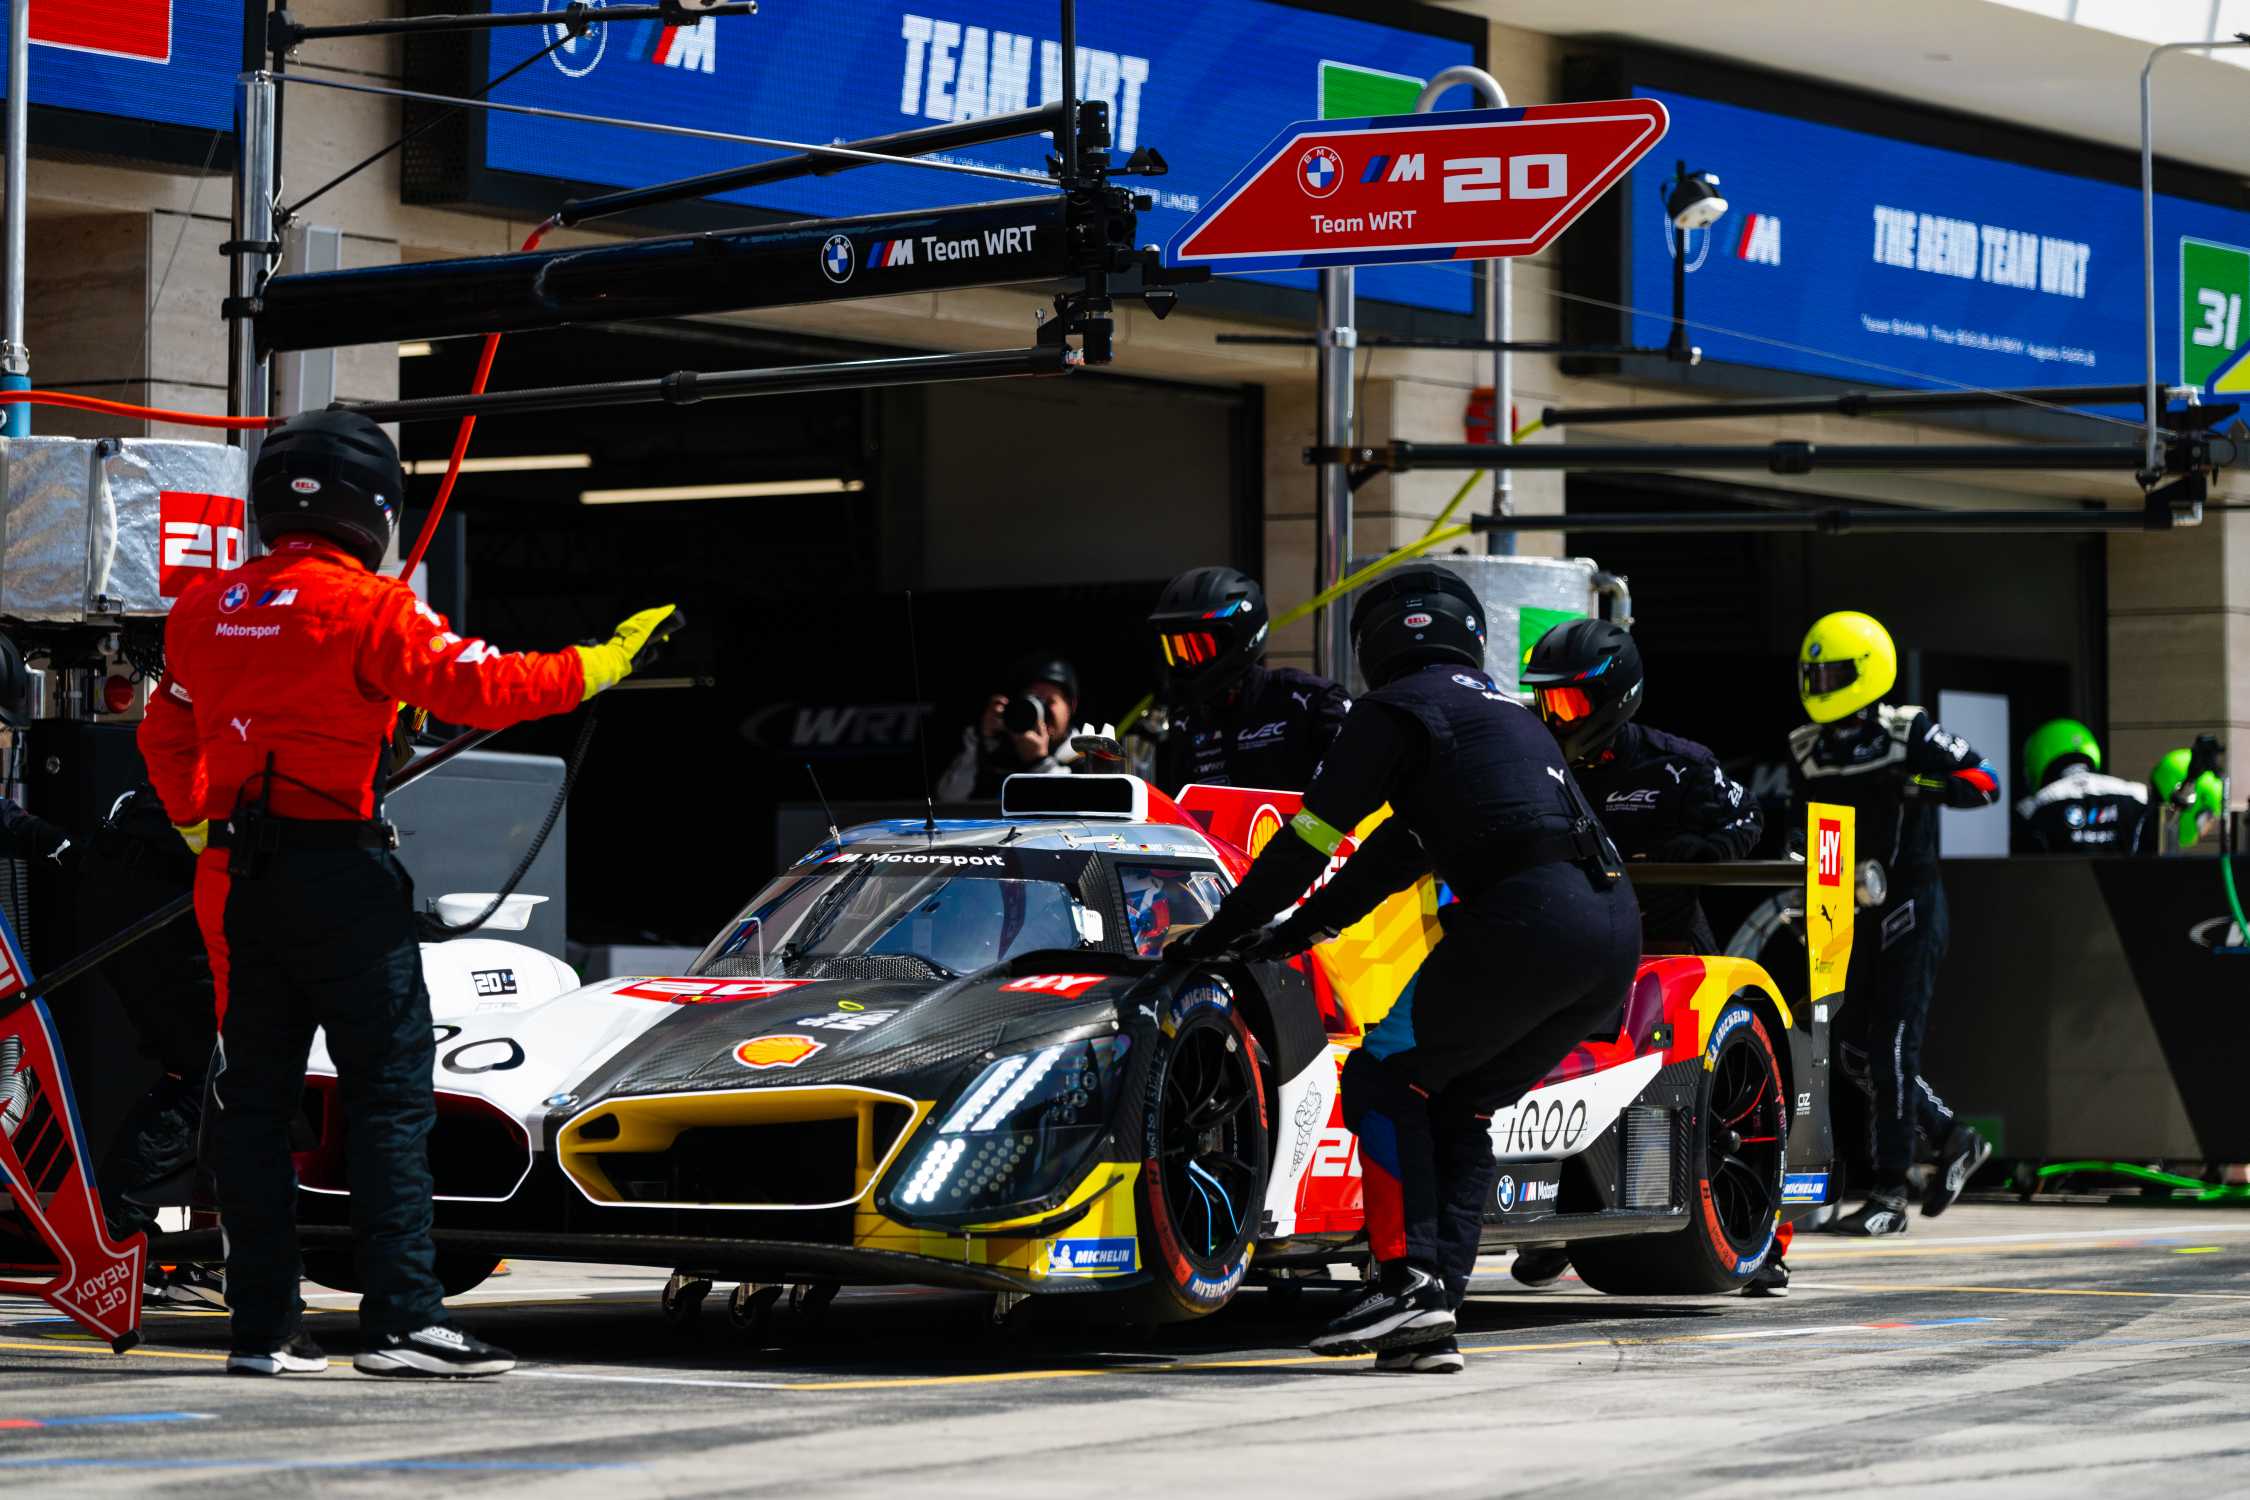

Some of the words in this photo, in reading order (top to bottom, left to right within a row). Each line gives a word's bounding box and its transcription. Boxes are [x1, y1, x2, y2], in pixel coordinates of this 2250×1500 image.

[900, 13, 1033, 122] TEAM
[1443, 153, 1568, 203] 20
[1311, 214, 1363, 234] Team
[1368, 210, 1417, 231] WRT
[921, 236, 980, 262] Team
[983, 225, 1037, 256] WRT
[1981, 224, 2039, 290] TEAM
[2192, 287, 2242, 351] 31
[164, 522, 245, 571] 20
[215, 623, 280, 639] Motorsport
[1606, 789, 1661, 803] WEC
[866, 853, 1006, 867] Motorsport
[1819, 829, 1840, 875] HY
[473, 973, 503, 993] 20
[633, 981, 799, 996] 20
[1009, 975, 1104, 991] HY
[1182, 986, 1229, 1010] MICHELIN
[1797, 1092, 1811, 1107] OZ
[1783, 1183, 1824, 1194] MICHELIN
[1075, 1249, 1130, 1264] MICHELIN
[75, 1261, 131, 1304] READY
[96, 1287, 128, 1317] GET
